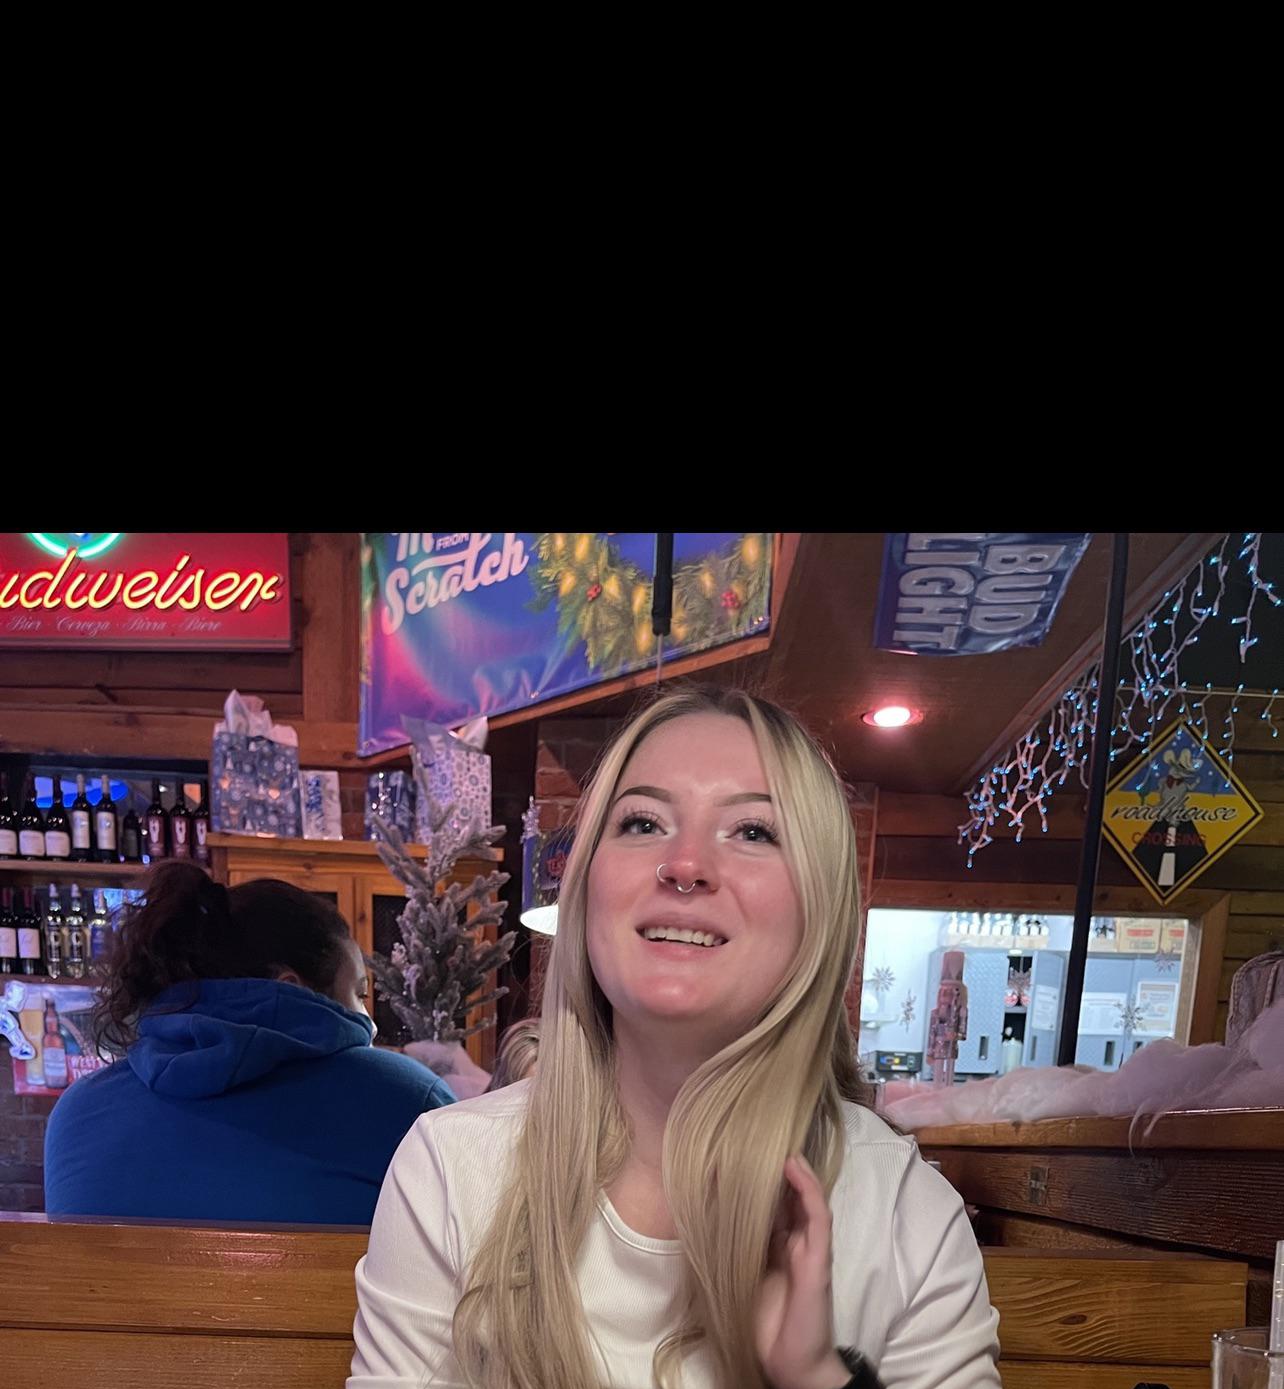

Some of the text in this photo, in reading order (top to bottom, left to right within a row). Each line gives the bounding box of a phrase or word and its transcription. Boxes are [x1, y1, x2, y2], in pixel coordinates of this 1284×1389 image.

[381, 533, 529, 636] Scratch
[435, 533, 471, 551] FROM
[968, 545, 1067, 634] BUD
[892, 533, 986, 650] LIGHT
